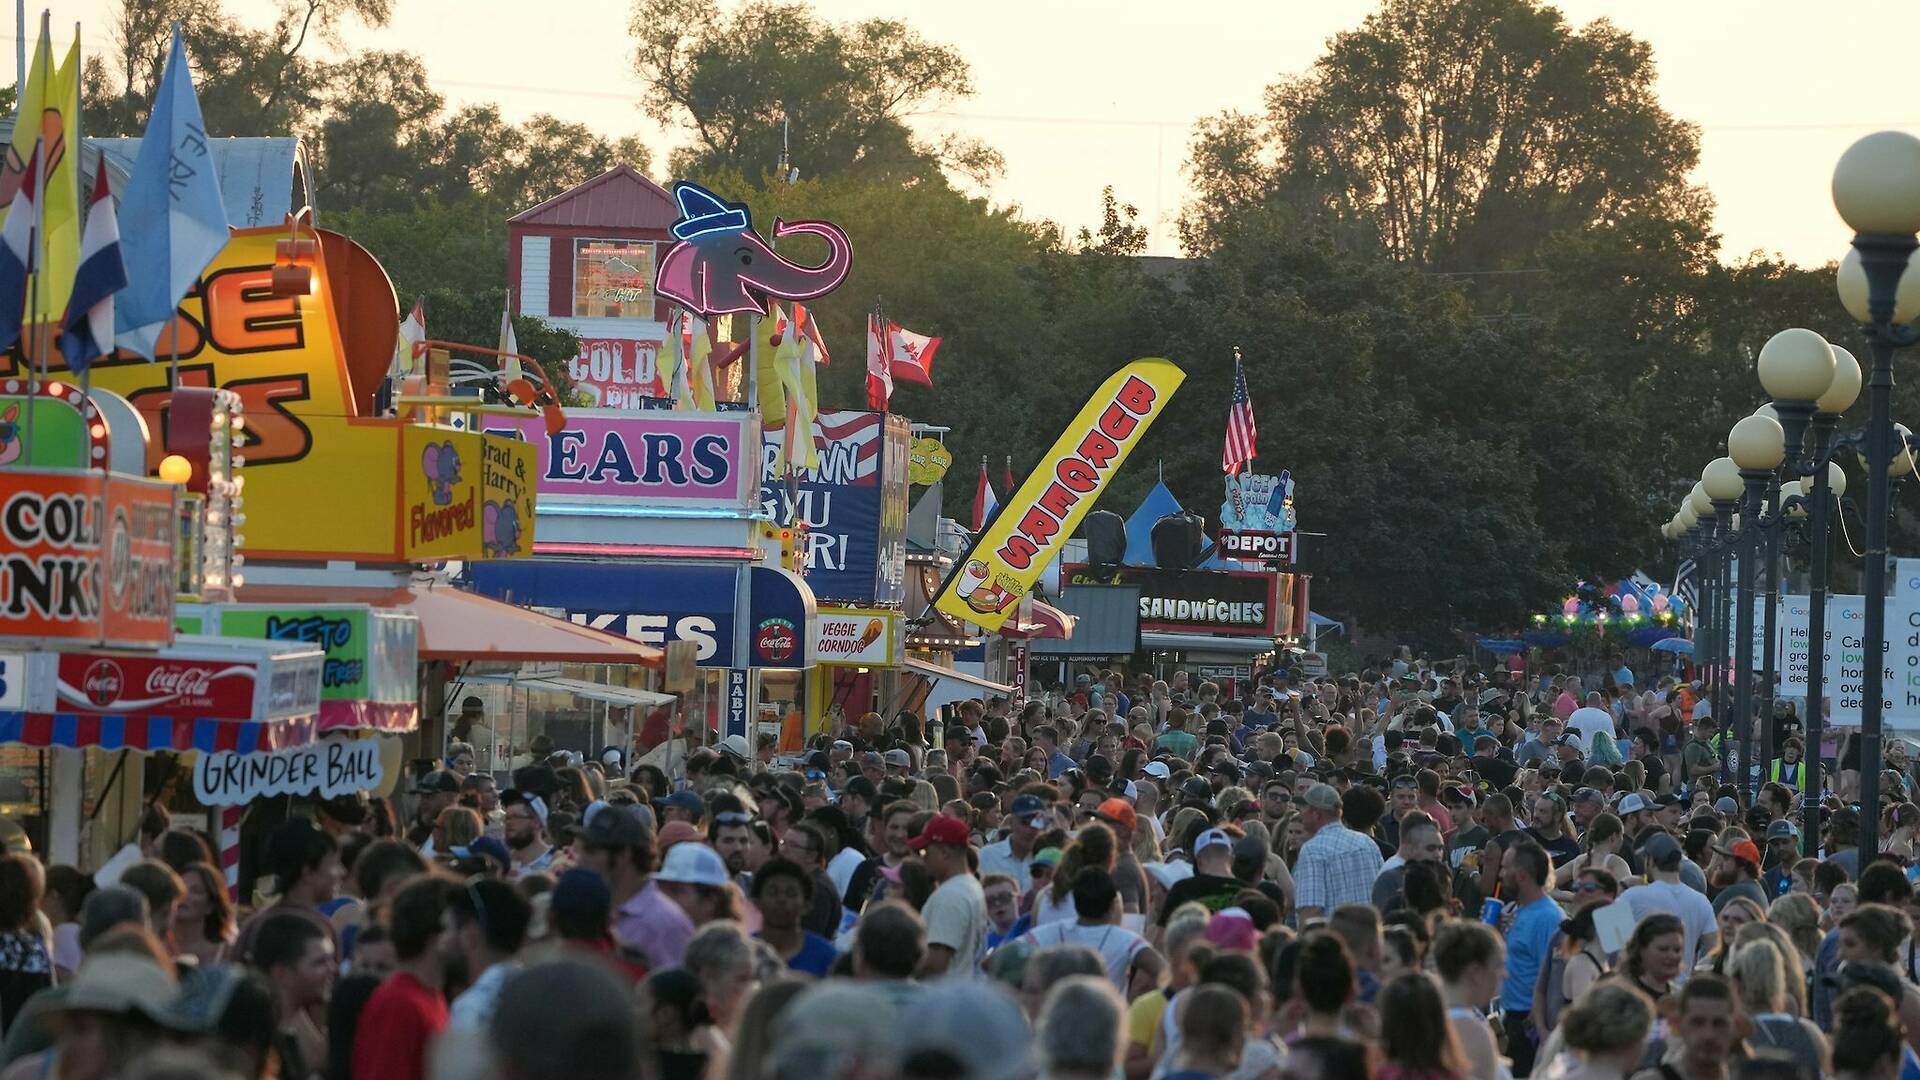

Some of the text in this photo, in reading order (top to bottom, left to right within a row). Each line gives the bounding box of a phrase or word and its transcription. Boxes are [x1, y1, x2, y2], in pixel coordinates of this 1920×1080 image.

[569, 341, 655, 384] COLD
[484, 429, 729, 485] EARS
[996, 374, 1157, 571] BURGERS
[411, 486, 475, 549] Flavored
[1227, 535, 1289, 552] DEPOT
[0, 556, 102, 619] NKS
[267, 616, 351, 652] KETO
[818, 638, 865, 654] CORNDOG
[822, 623, 857, 636] VEGGIE
[1789, 664, 1809, 672] ove
[731, 672, 745, 722] BABY
[203, 744, 377, 795] GRINDER BALL
